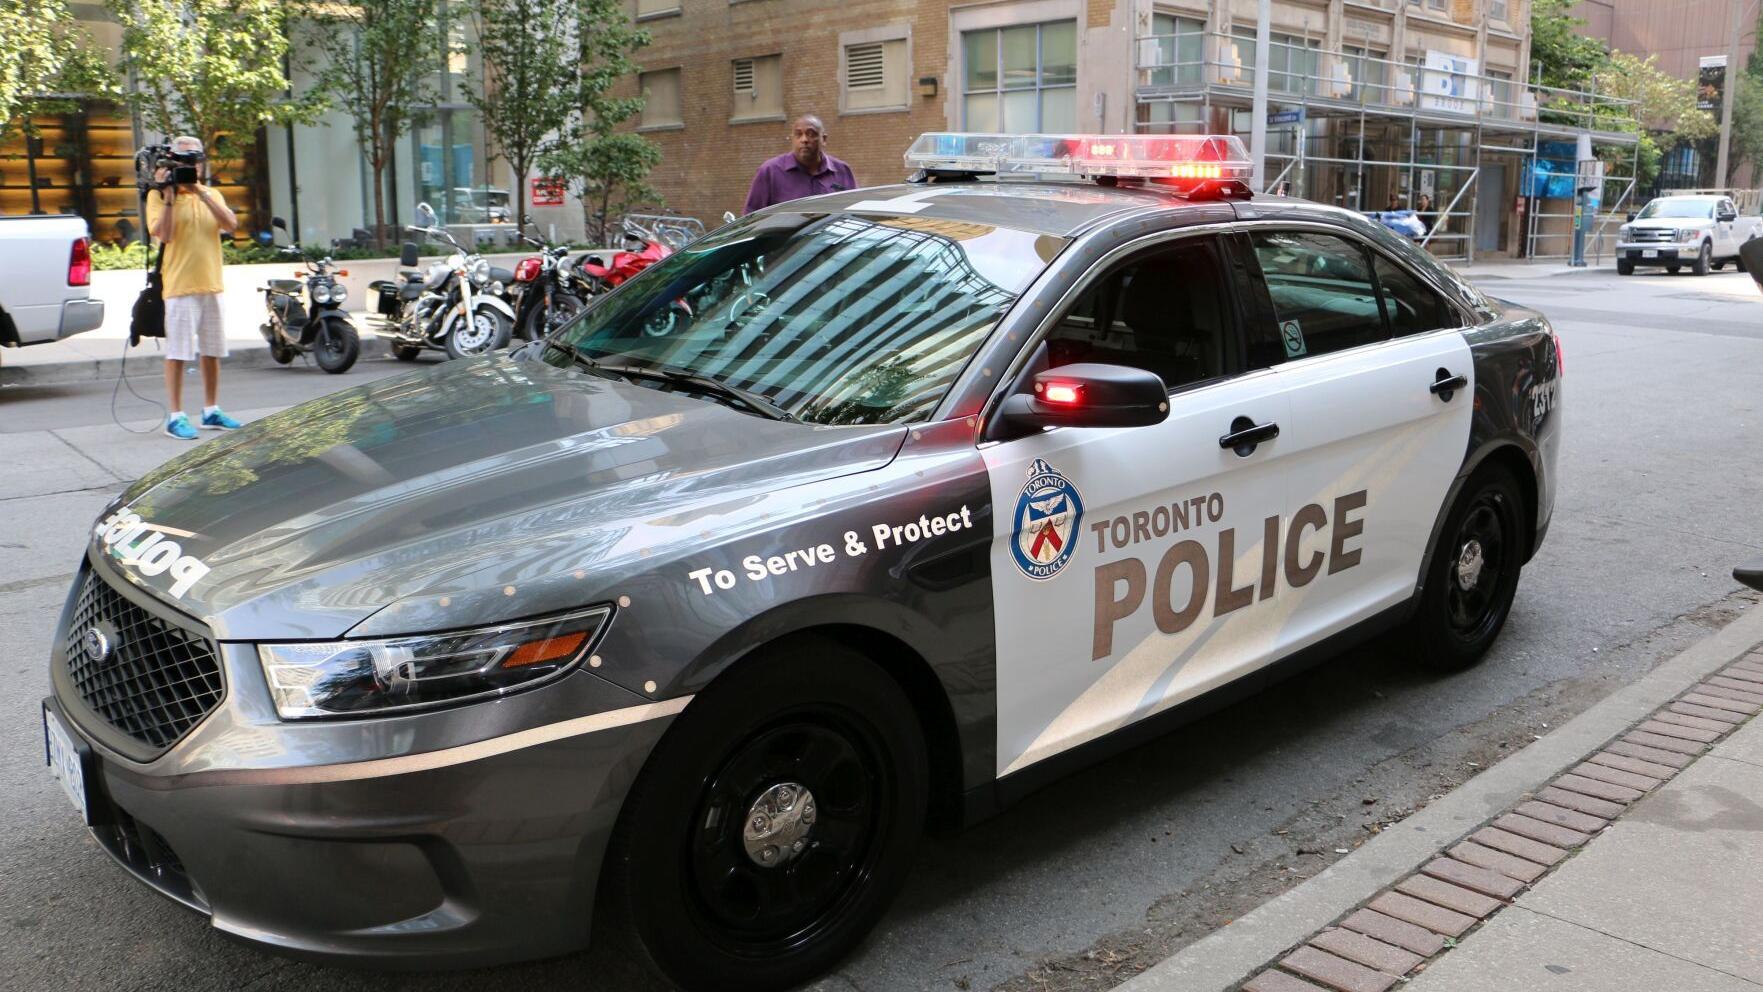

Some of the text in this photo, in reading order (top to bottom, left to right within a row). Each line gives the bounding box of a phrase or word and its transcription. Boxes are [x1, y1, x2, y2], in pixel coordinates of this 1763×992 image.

[1025, 477, 1065, 497] TORONTO
[689, 504, 973, 595] To Serve & Protect
[1091, 492, 1224, 553] TORONTO
[1034, 560, 1063, 575] POLICE
[1092, 489, 1367, 662] POLICE
